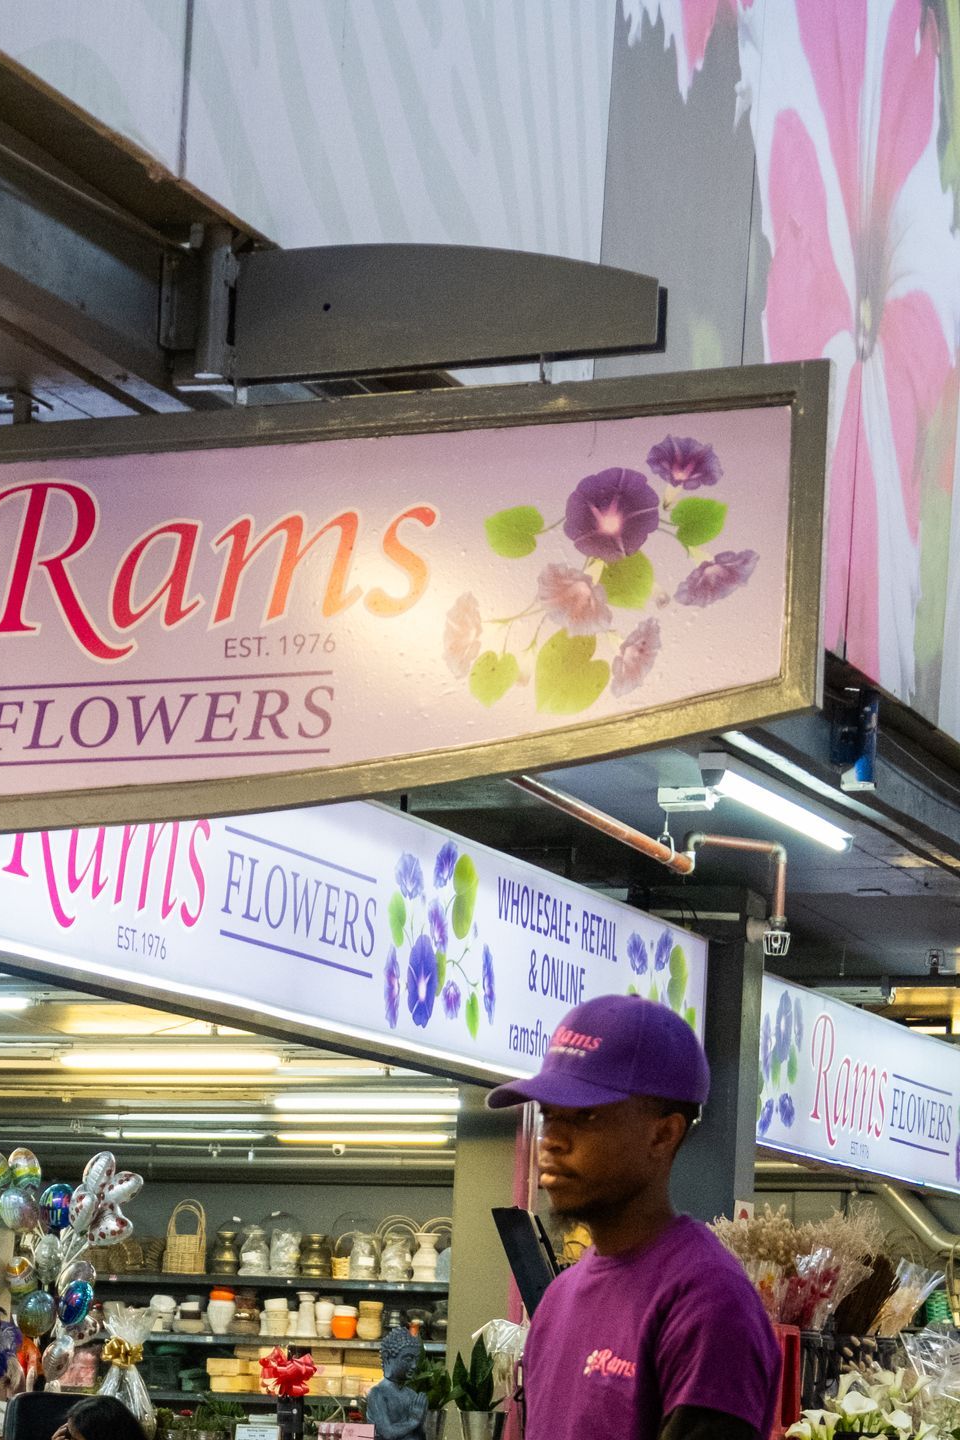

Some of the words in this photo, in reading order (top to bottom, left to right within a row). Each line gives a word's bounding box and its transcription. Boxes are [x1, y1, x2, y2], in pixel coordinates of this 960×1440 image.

[224, 637, 270, 659] EST.
[279, 632, 337, 657] 1976
[221, 849, 377, 958] FLOWERS
[498, 876, 572, 945] WHOLESALE
[581, 910, 618, 963] RETAIL
[117, 925, 139, 954] EST.
[141, 931, 167, 960] 1976
[528, 948, 538, 993] &
[541, 953, 586, 1006] ONLINE
[508, 1018, 551, 1059] ramsflo
[811, 1014, 888, 1147] Rams
[889, 1088, 953, 1144] FLOWERS
